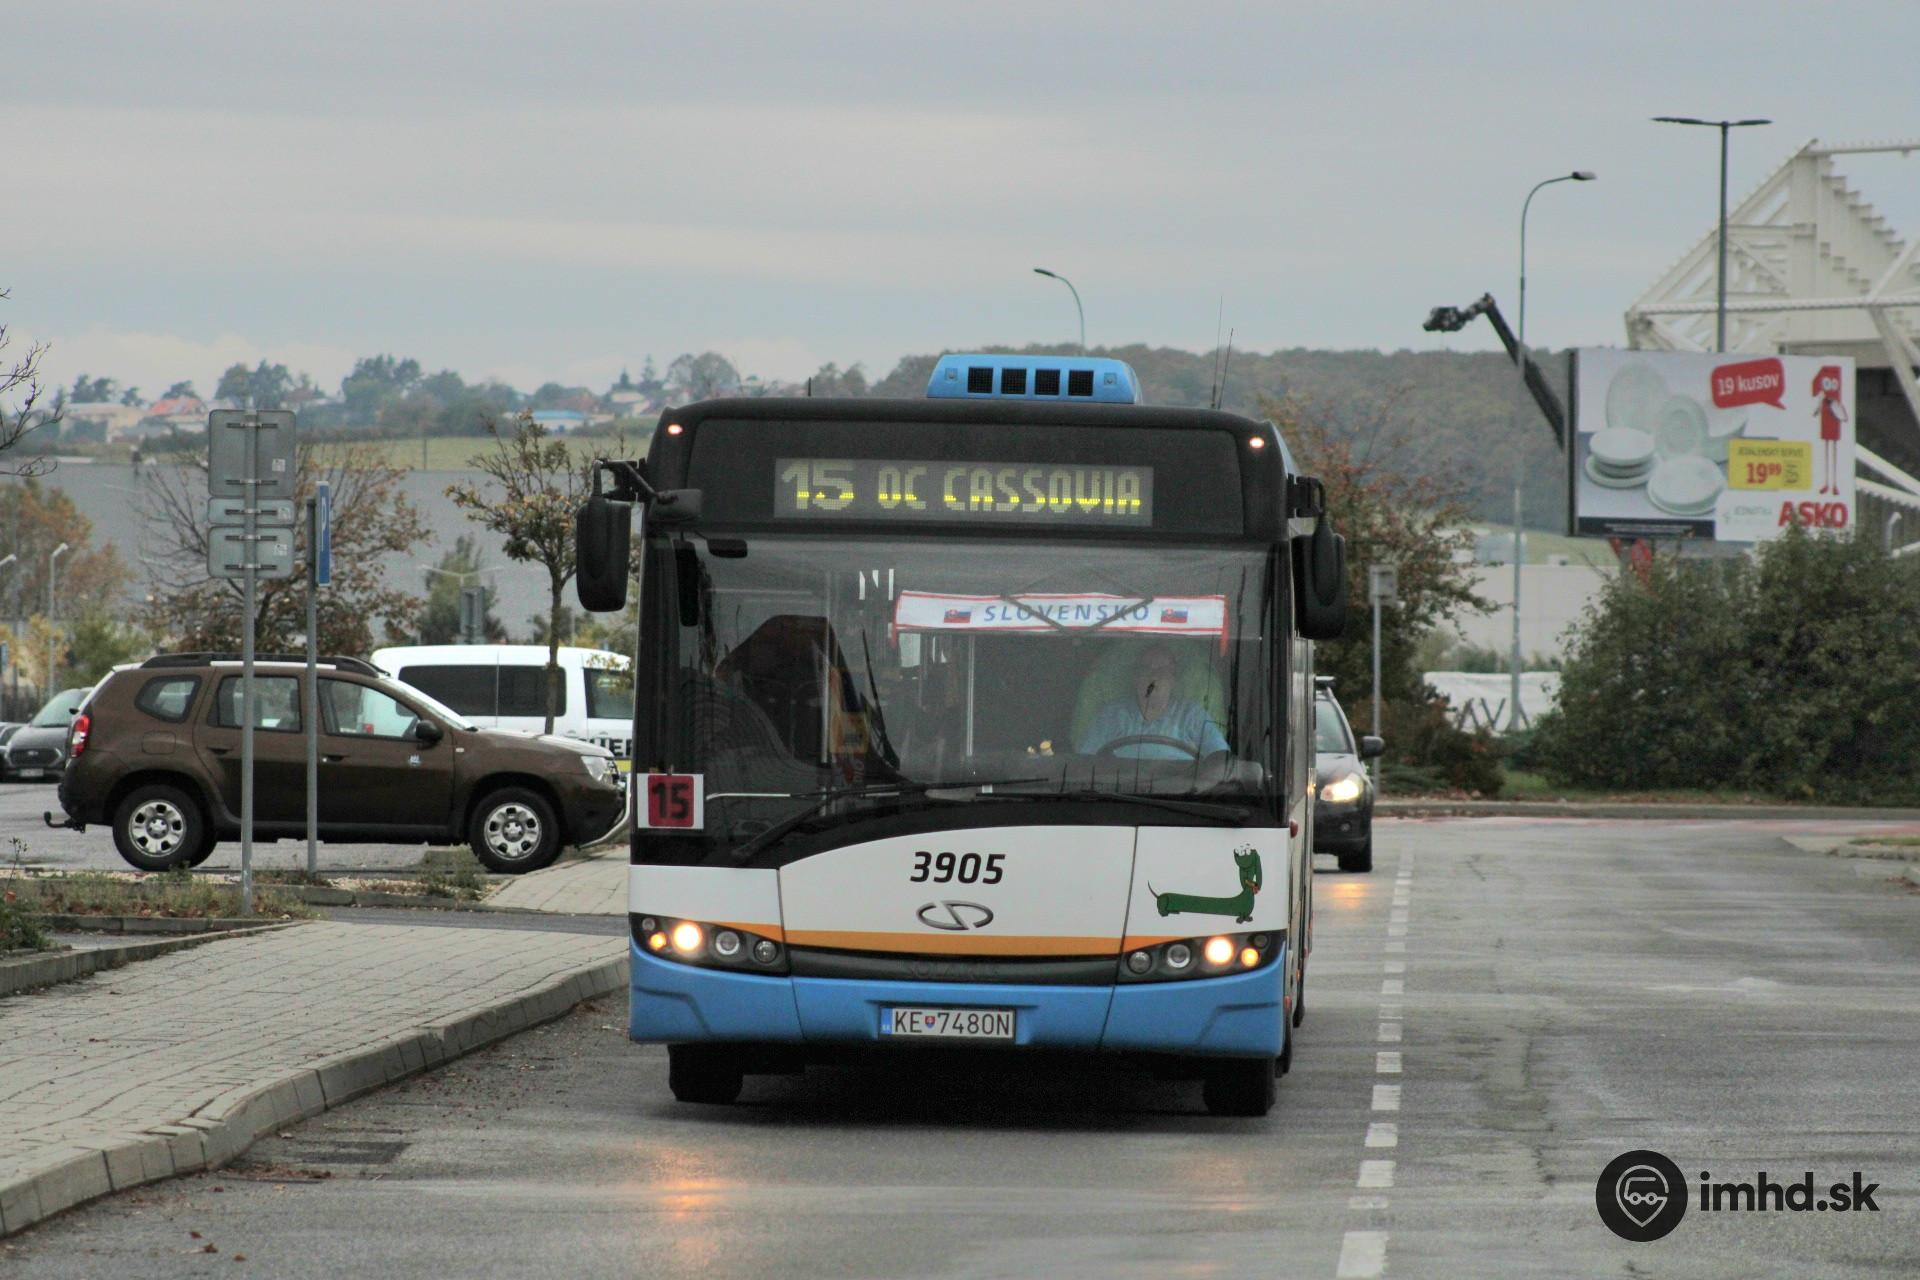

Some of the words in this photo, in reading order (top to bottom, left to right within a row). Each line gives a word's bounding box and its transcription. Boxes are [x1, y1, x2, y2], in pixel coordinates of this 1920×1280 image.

[1718, 378, 1735, 396] 19
[1738, 371, 1779, 393] kusov
[781, 459, 854, 511] 15
[877, 466, 927, 511] OC
[942, 467, 1141, 516] CASSOVIA
[1778, 501, 1848, 528] ASKO
[984, 603, 1150, 622] SLOVENSKO
[652, 781, 691, 820] 15
[909, 851, 1006, 884] 3905
[895, 1011, 922, 1033] KE
